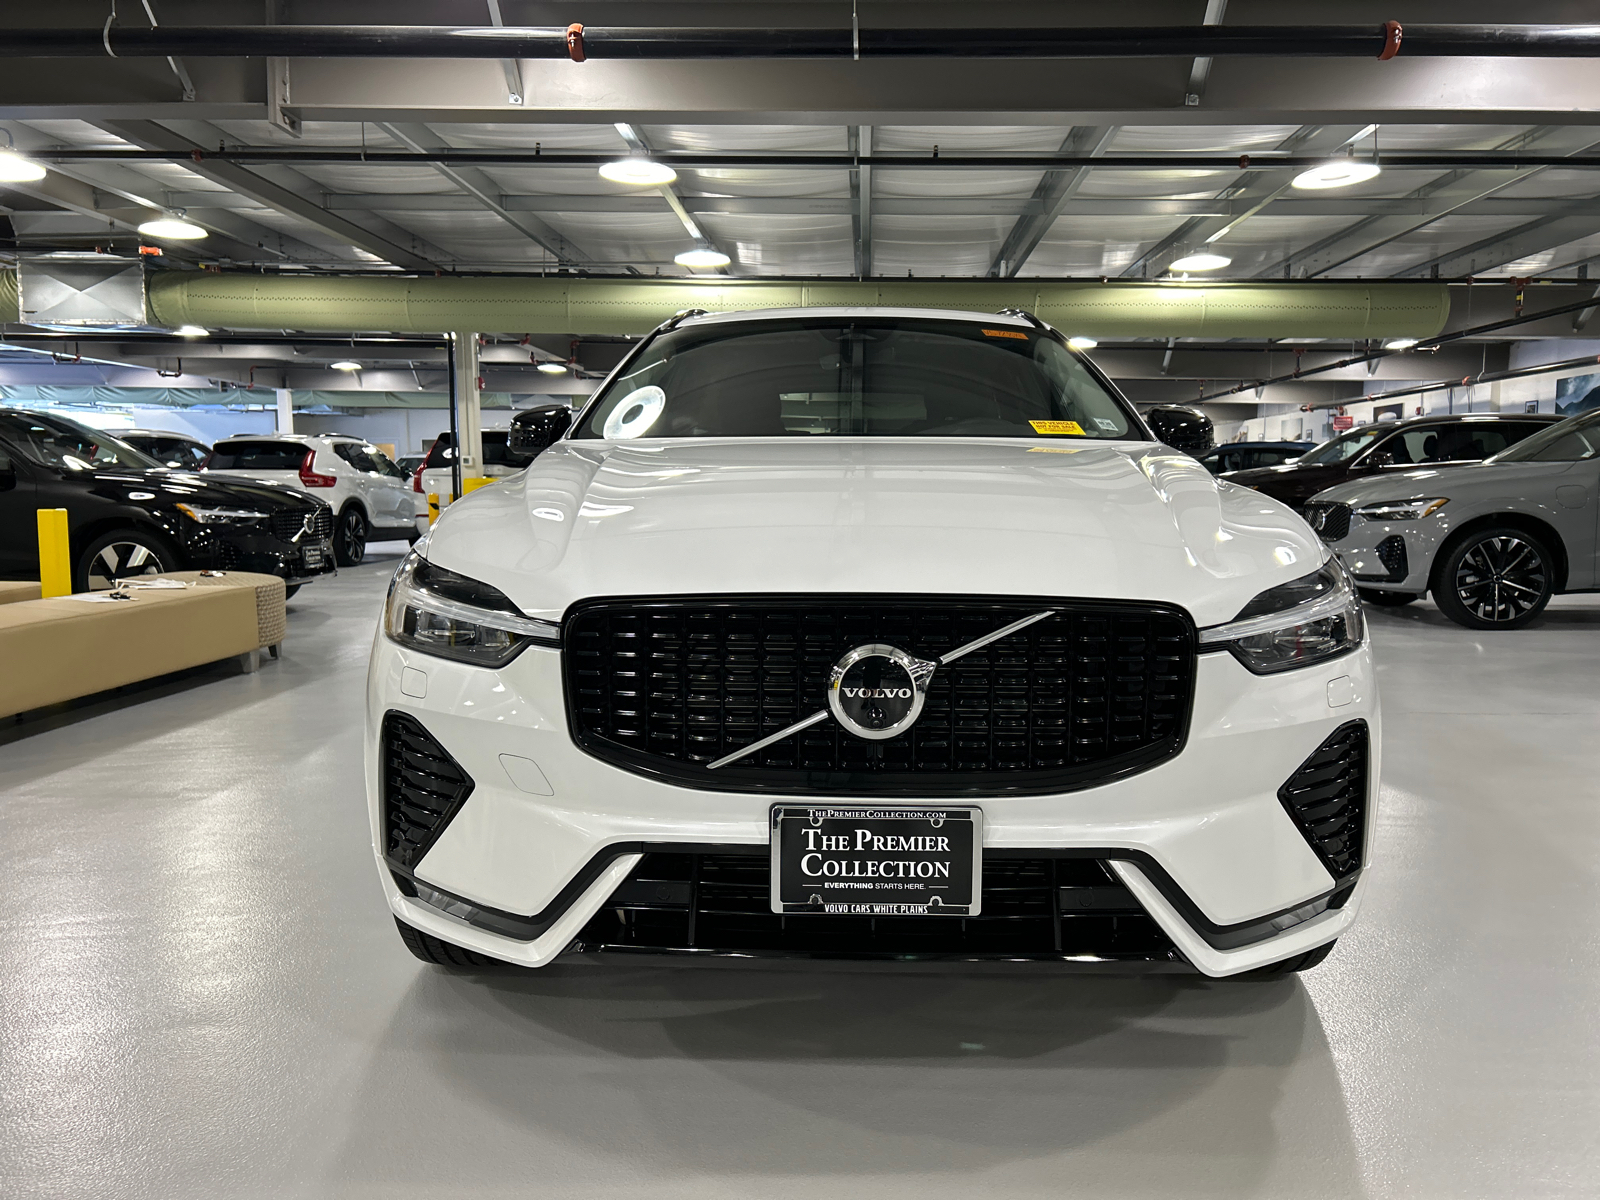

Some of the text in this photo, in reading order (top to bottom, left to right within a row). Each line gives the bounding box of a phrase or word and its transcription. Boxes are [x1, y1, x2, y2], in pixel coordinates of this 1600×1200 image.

[842, 687, 912, 698] VOLVO
[824, 904, 928, 914] VOLVO CARS WHITE PLAINS
